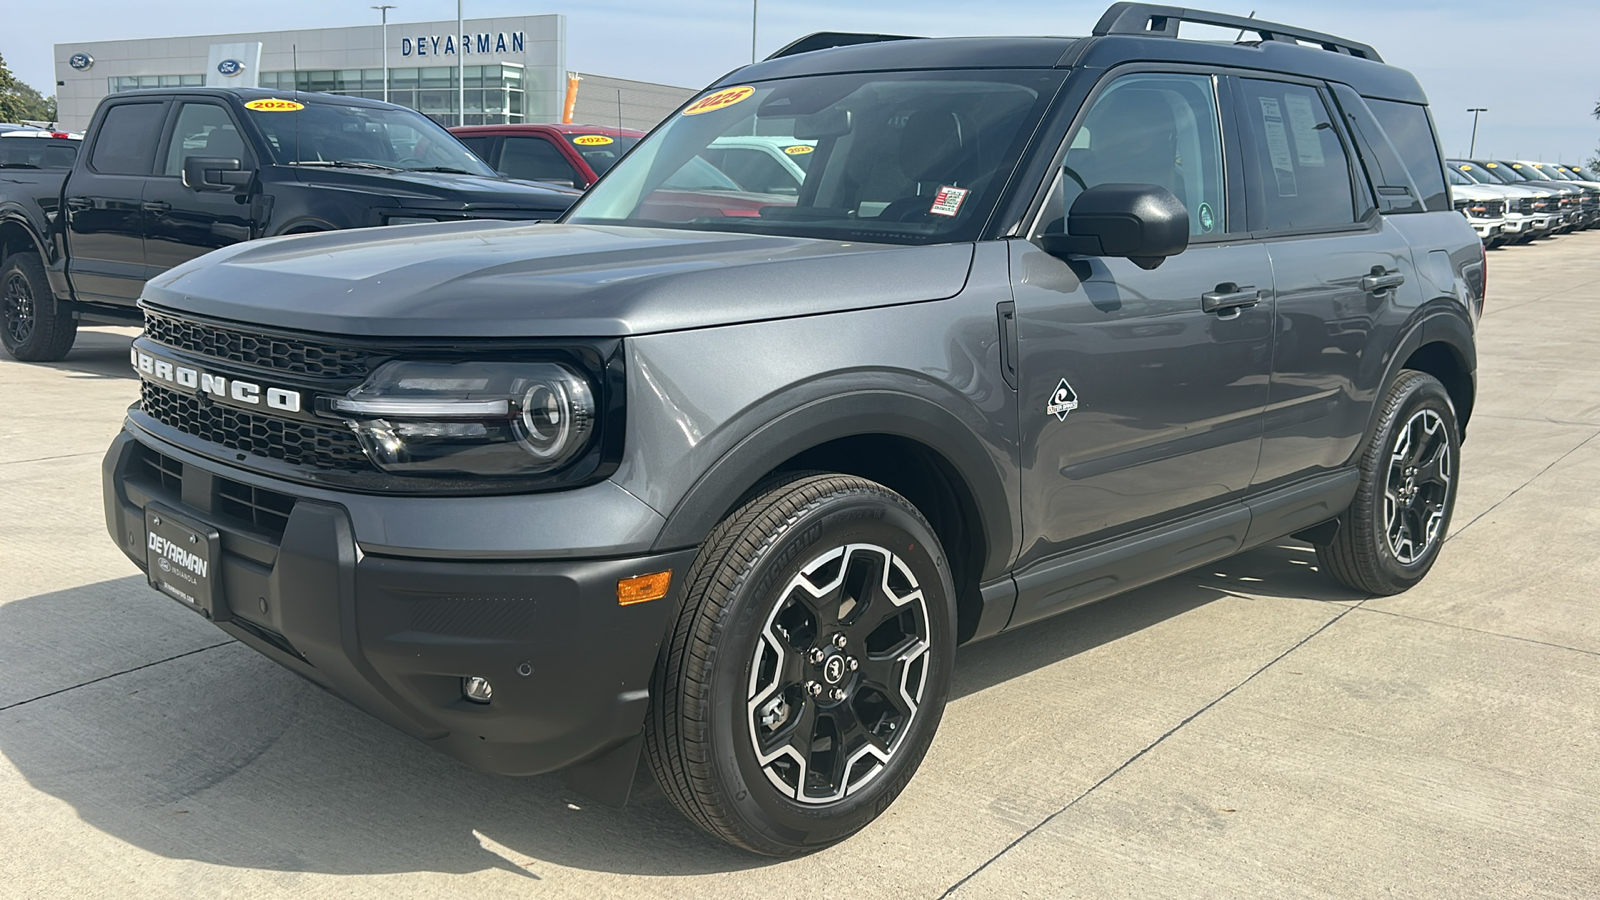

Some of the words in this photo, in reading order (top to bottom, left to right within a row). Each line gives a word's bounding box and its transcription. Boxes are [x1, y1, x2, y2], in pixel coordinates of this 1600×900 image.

[402, 31, 525, 56] DEYARMAN
[690, 88, 750, 111] 2025
[579, 136, 611, 144] 2025
[788, 146, 811, 154] 2025
[138, 353, 301, 413] BRONCO
[149, 531, 208, 578] DEYARMAN
[754, 524, 820, 602] MICHELIN
[171, 566, 198, 585] INDIANOLA
